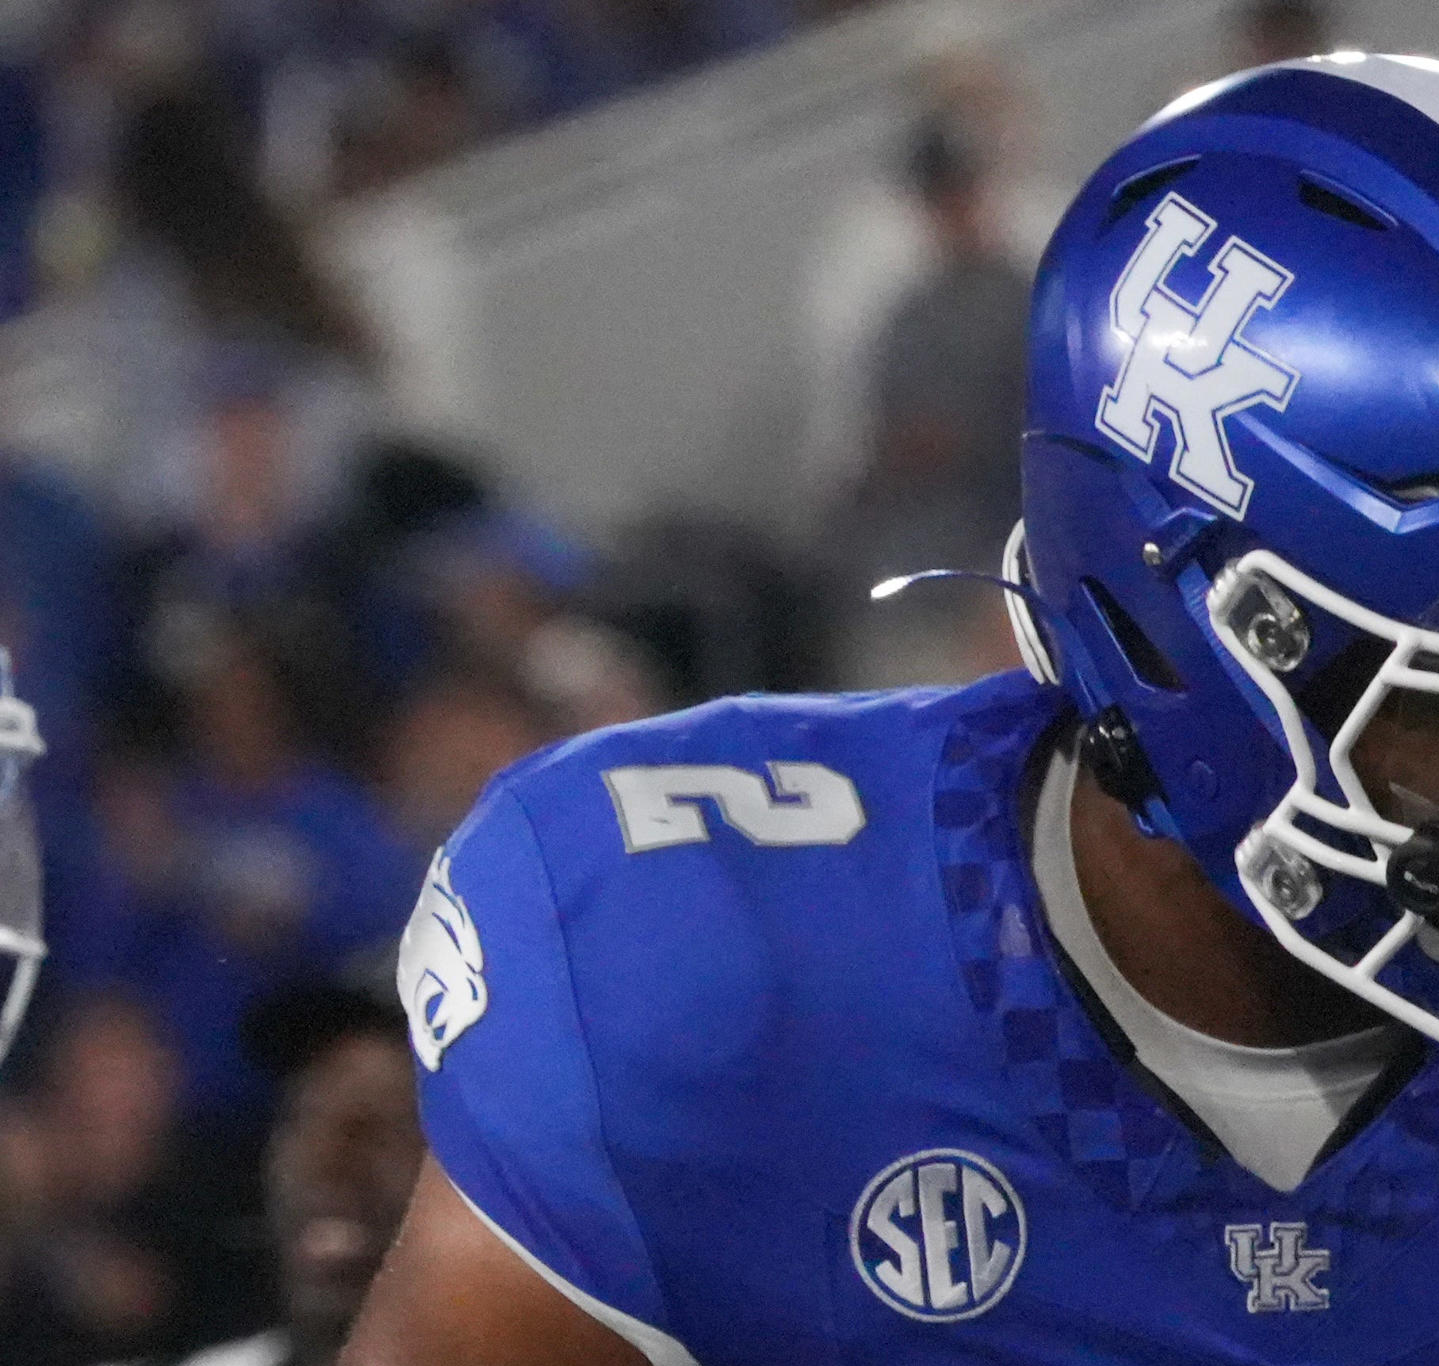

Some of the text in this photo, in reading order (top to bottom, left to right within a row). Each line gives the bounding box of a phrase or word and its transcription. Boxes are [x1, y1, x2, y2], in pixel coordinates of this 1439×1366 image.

[1095, 191, 1301, 521] UK
[602, 761, 866, 854] 2
[866, 1162, 1012, 1311] SEC
[1225, 1222, 1331, 1314] UK
